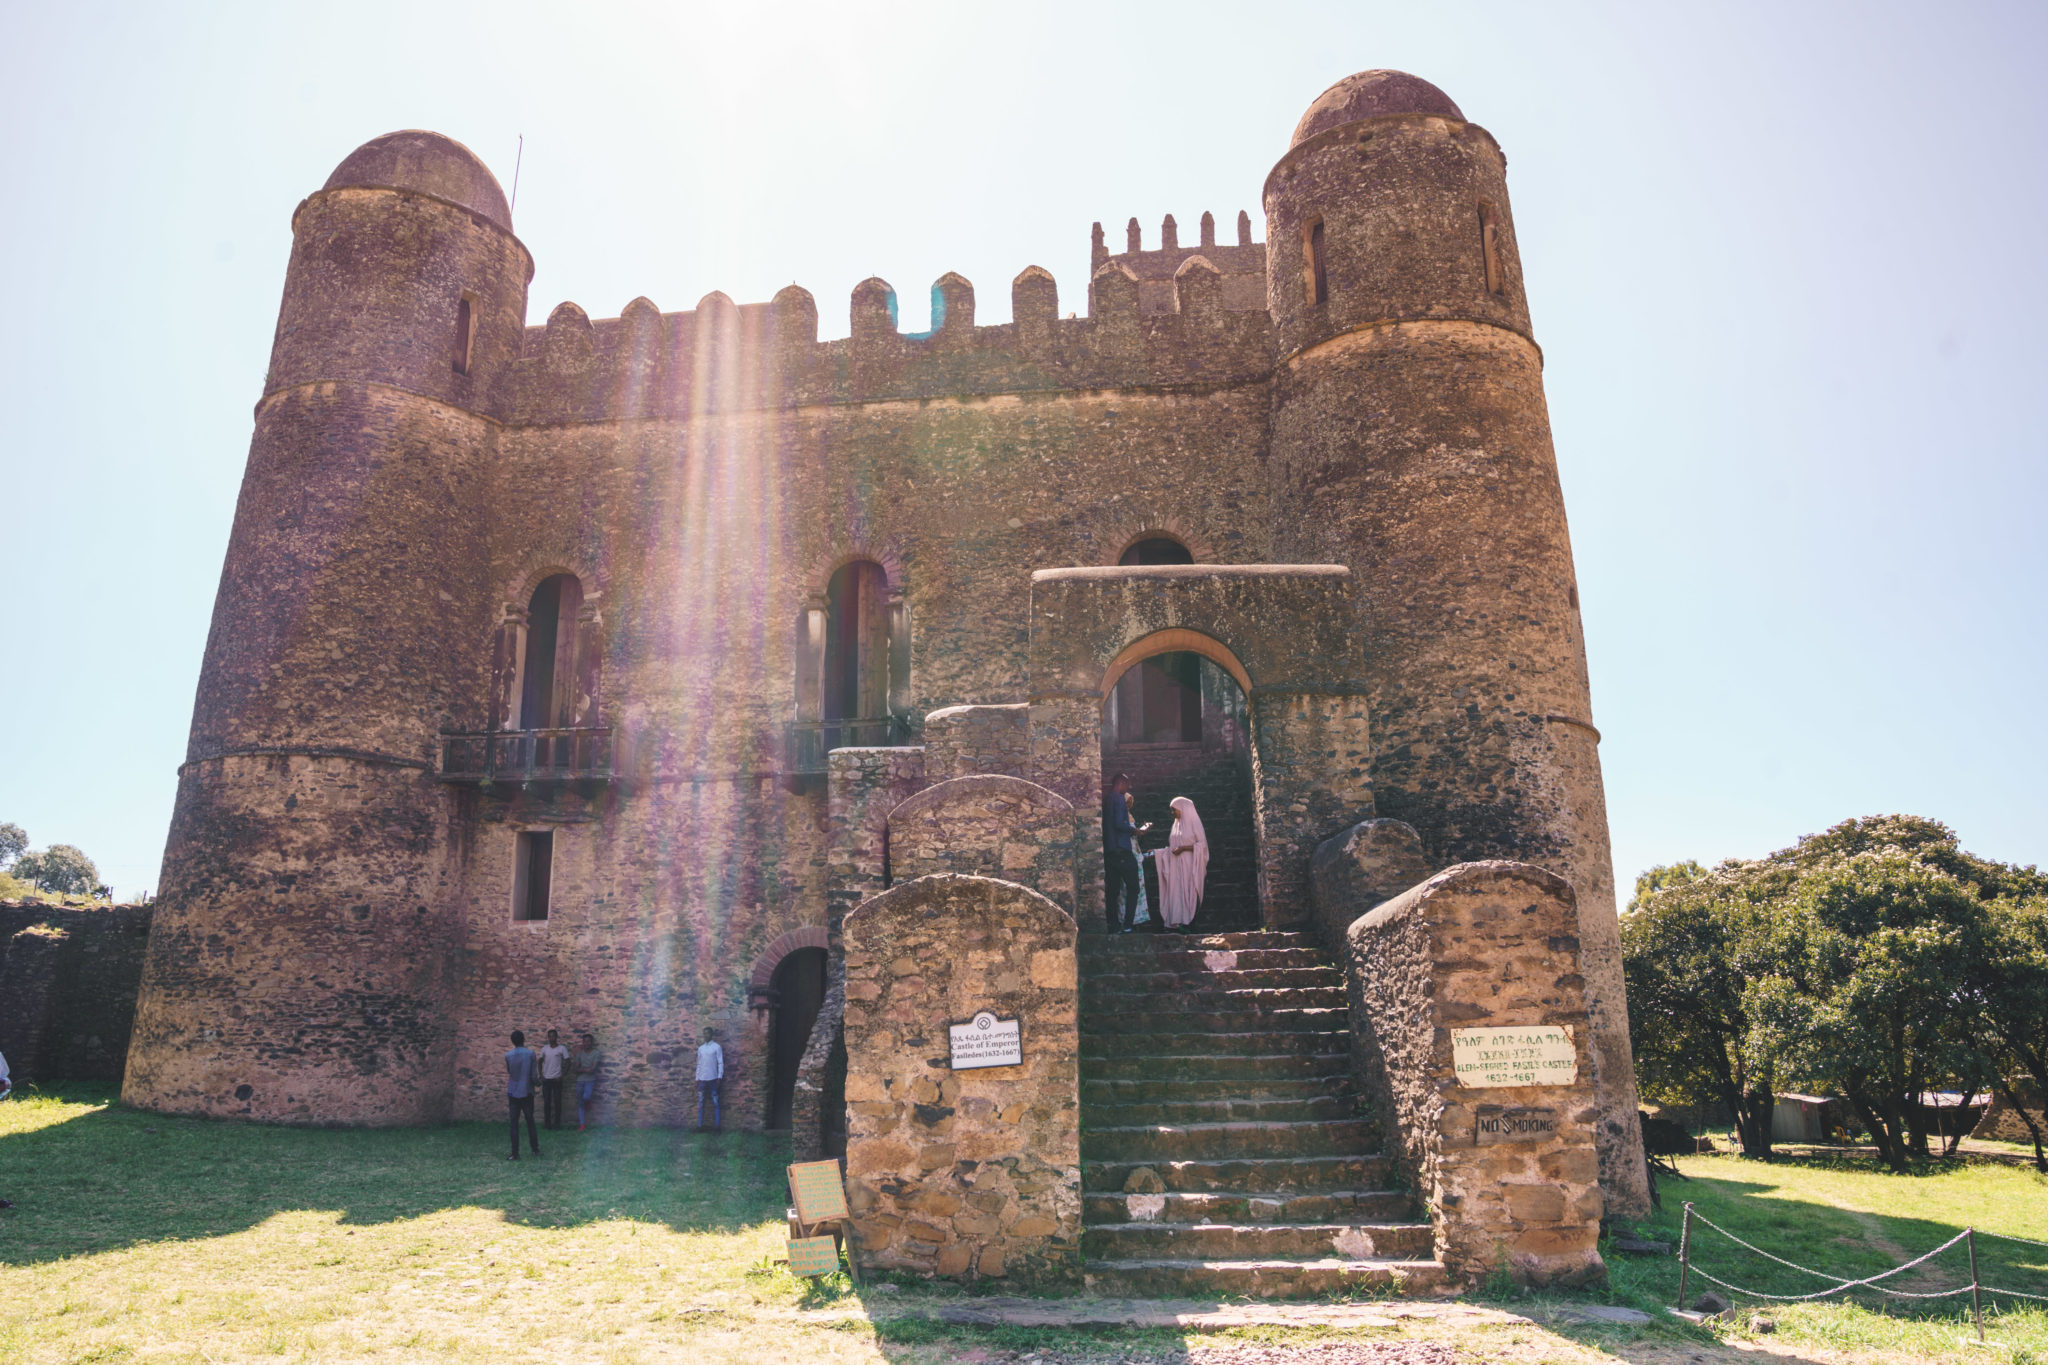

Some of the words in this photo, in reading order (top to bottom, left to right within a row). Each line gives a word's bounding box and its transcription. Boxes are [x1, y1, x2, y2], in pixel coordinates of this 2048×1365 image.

[951, 1042, 974, 1050] Castle
[976, 1041, 984, 1049] of
[985, 1039, 1019, 1049] Emperor
[1542, 1060, 1573, 1070] CASTLE
[1481, 1119, 1499, 1133] NO
